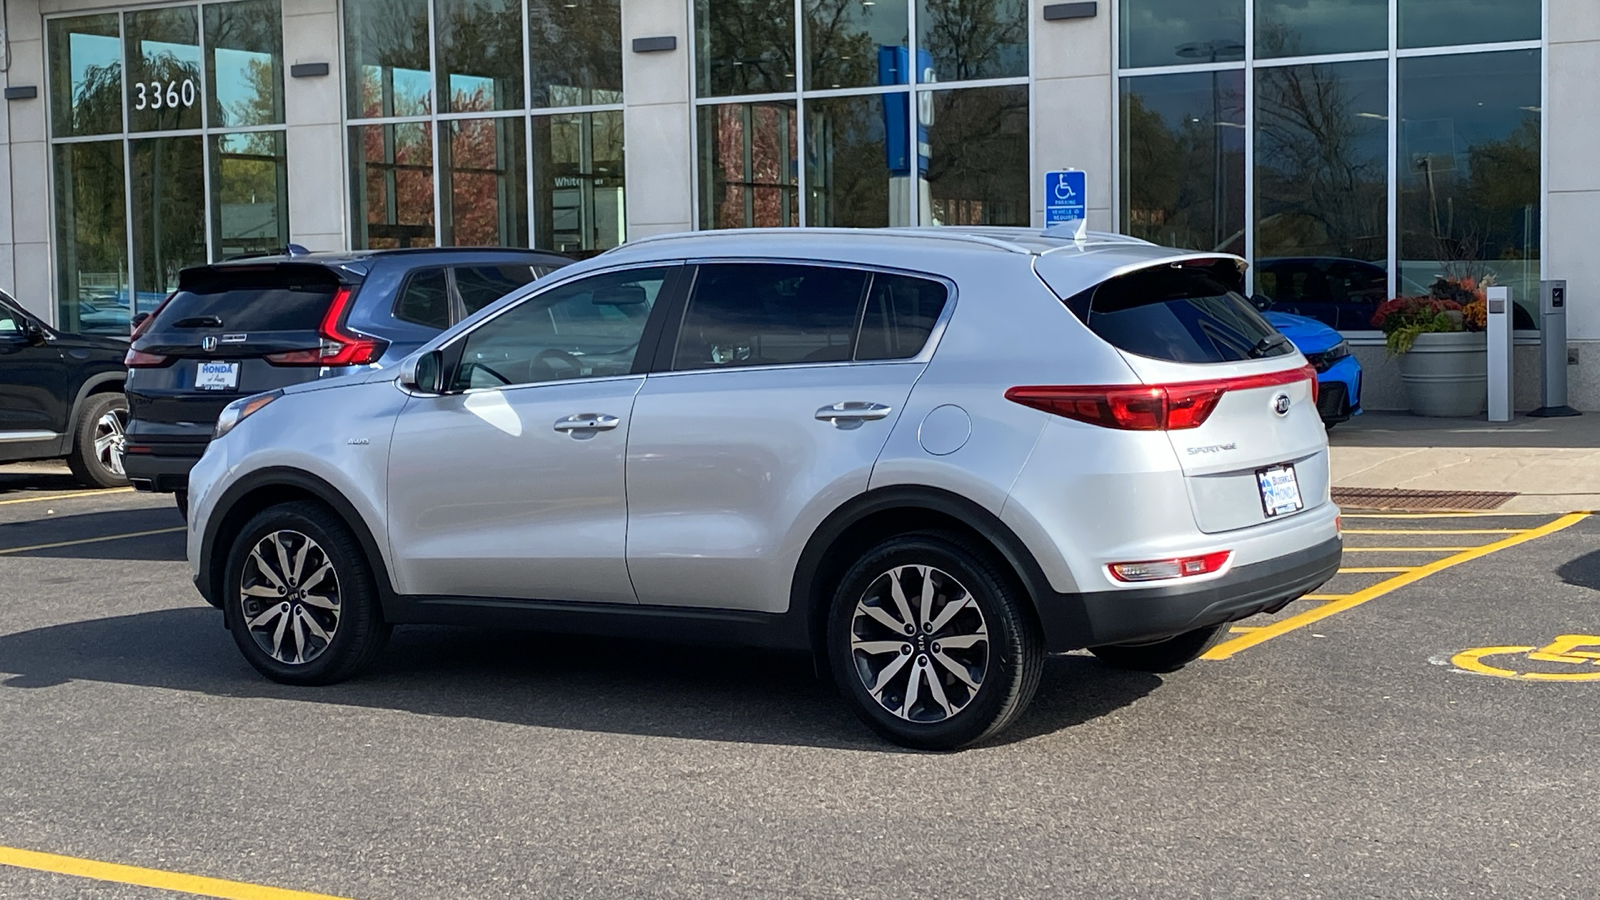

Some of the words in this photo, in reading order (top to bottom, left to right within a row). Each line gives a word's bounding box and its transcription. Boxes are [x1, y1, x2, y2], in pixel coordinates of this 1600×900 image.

[135, 79, 195, 110] 3360
[202, 365, 232, 374] HONDA
[1273, 485, 1297, 503] HONDA
[917, 634, 925, 651] KIA
